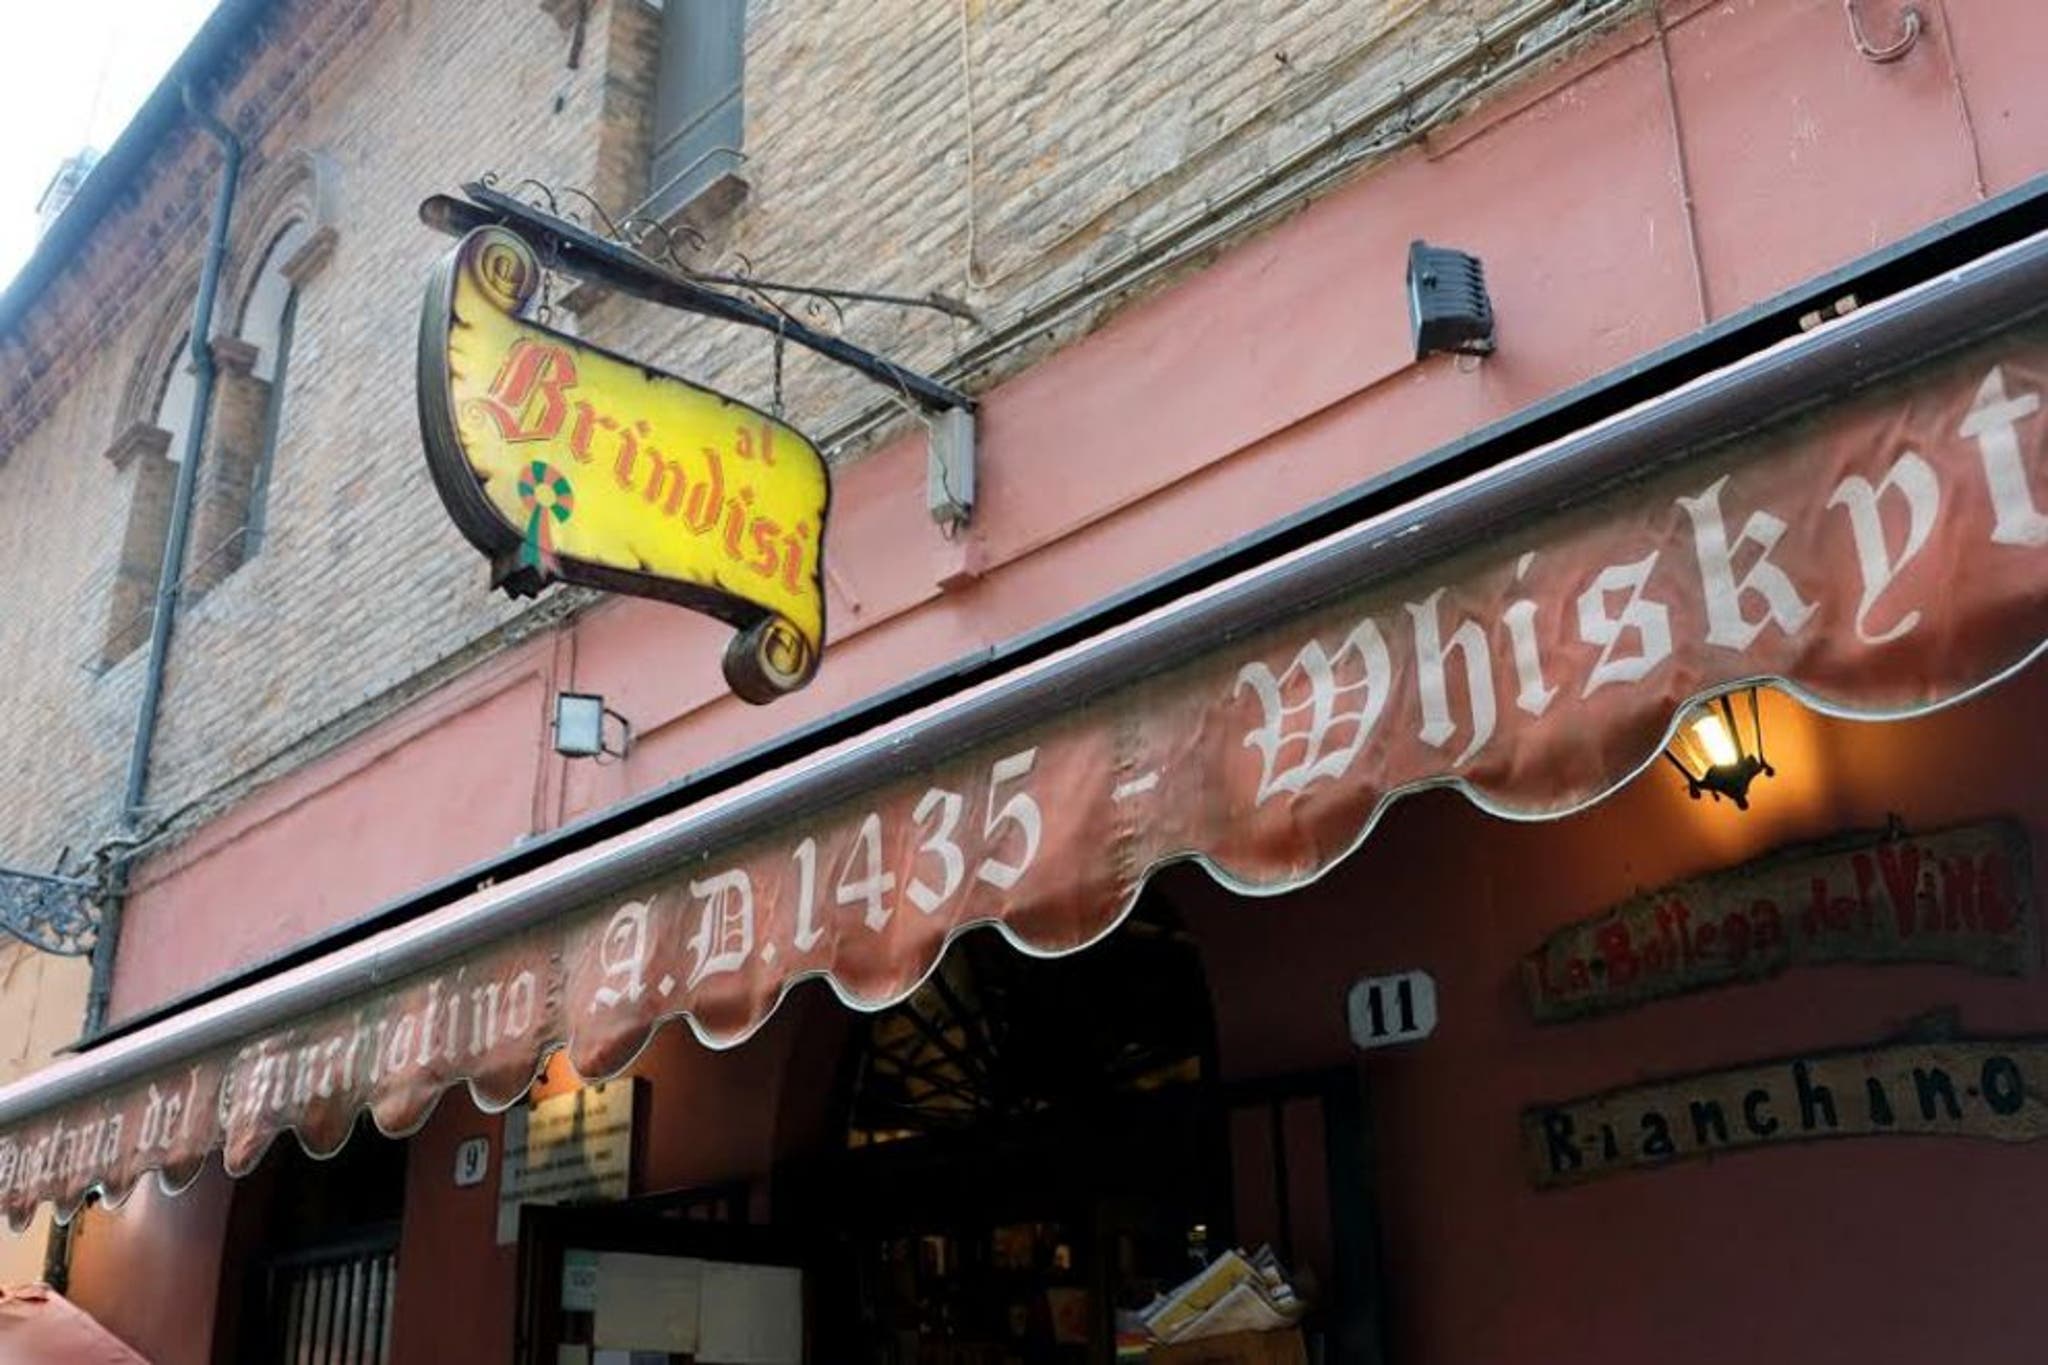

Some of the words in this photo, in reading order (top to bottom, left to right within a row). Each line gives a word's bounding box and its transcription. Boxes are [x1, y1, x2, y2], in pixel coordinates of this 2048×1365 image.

[469, 337, 808, 595] Brindisi
[735, 423, 775, 468] al
[1597, 898, 1784, 986] Bottega
[1367, 979, 1419, 1037] 11
[137, 1065, 202, 1151] del
